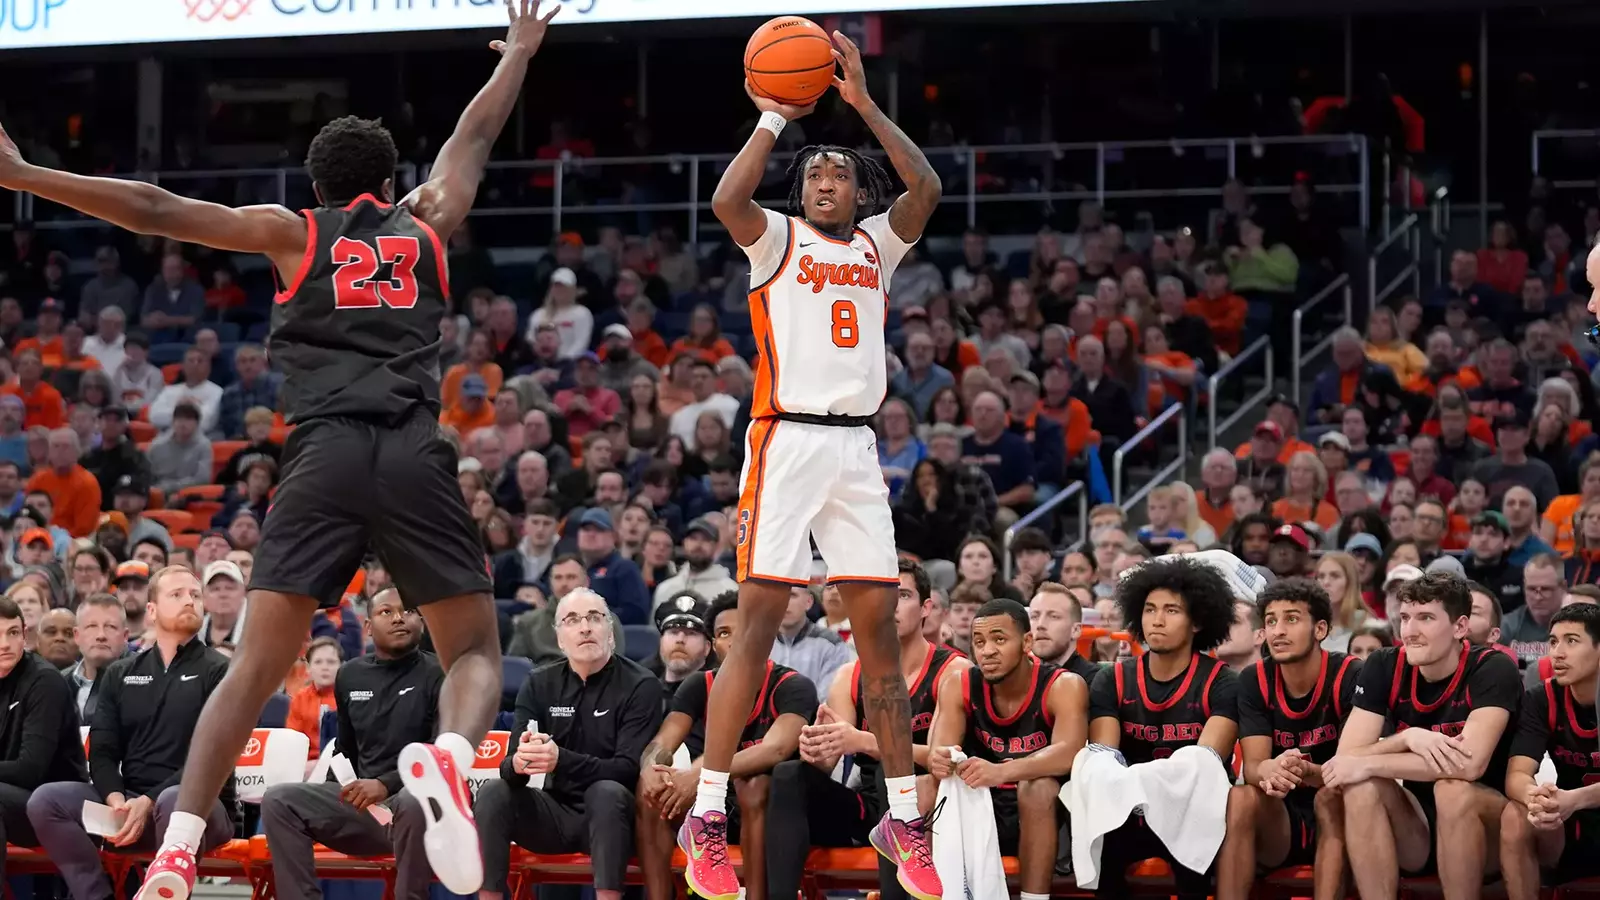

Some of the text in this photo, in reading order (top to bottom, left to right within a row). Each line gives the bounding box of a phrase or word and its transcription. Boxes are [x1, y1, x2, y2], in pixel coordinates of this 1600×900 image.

[331, 236, 420, 309] 23
[831, 299, 860, 349] 8
[1008, 731, 1048, 754] RED
[1162, 722, 1204, 741] RED
[1299, 723, 1337, 748] RED
